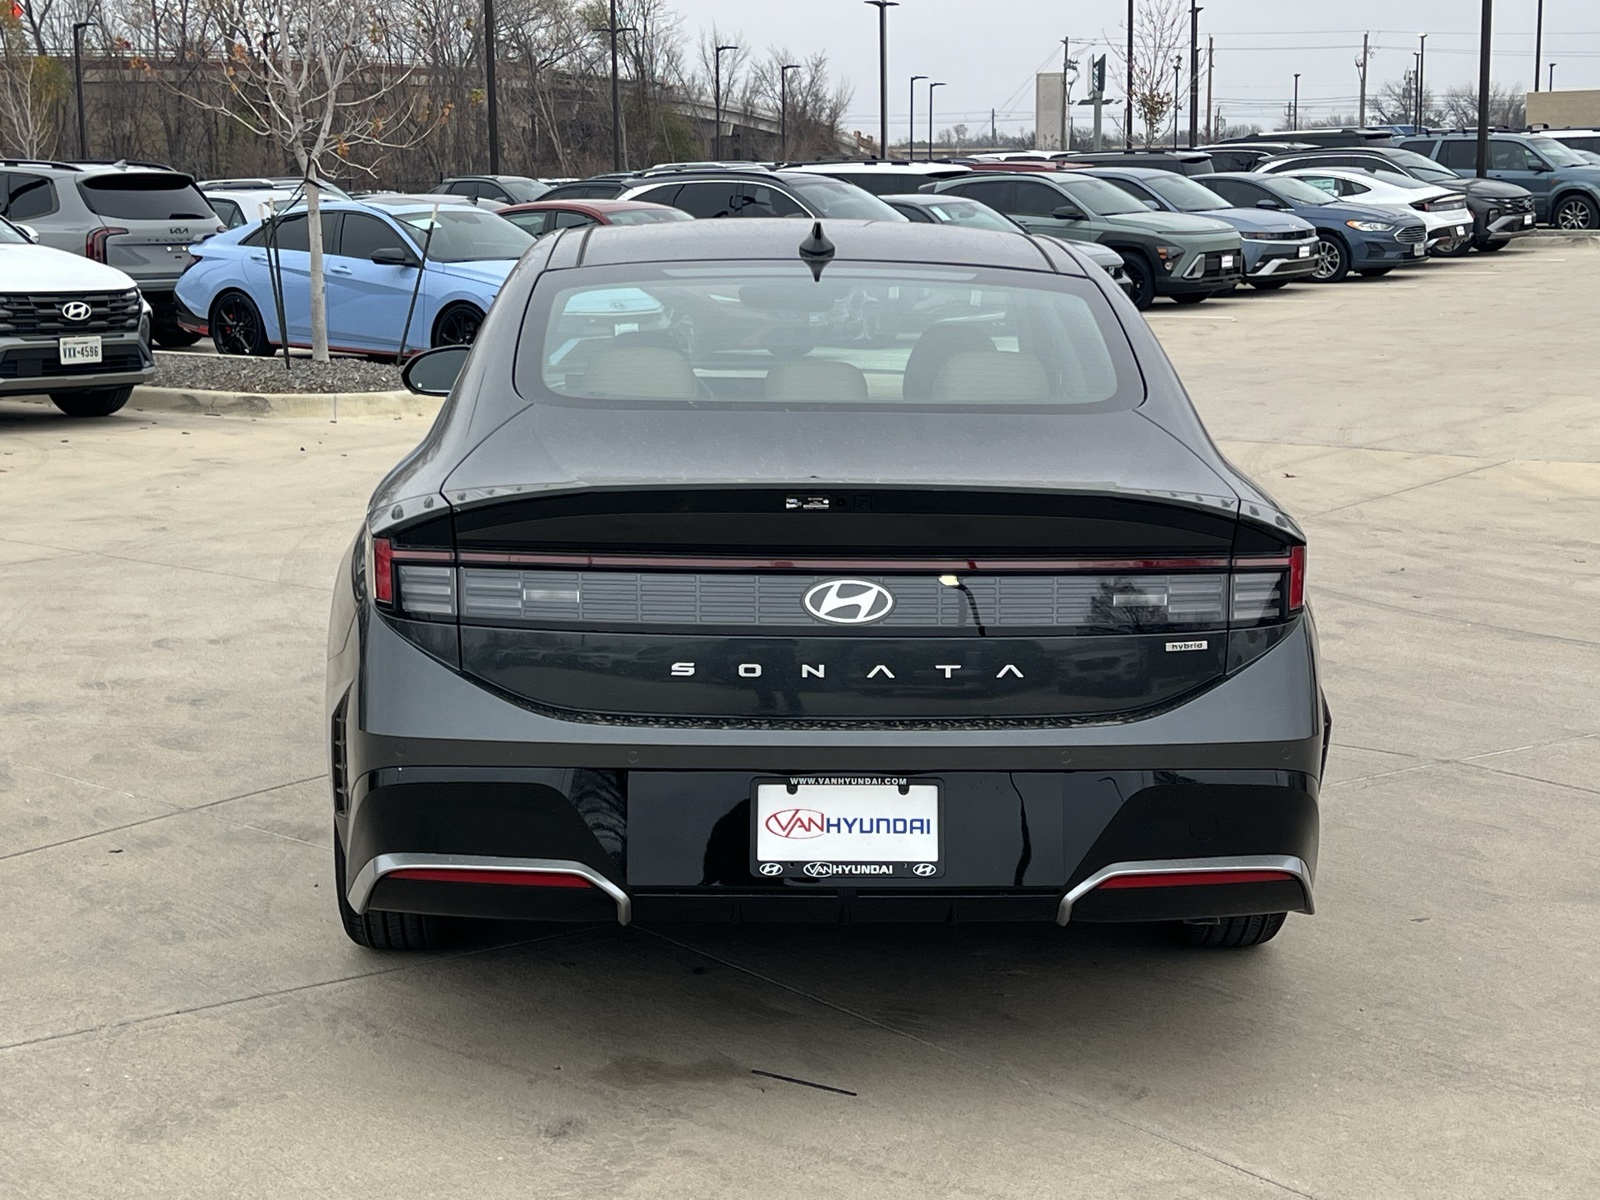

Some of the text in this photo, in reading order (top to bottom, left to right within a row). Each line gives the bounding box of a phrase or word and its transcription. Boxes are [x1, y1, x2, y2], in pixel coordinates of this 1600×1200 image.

[1171, 642, 1204, 651] hybrid
[670, 662, 1025, 679] SONATA
[789, 777, 908, 785] WWW.VANHYUNDAI.COM
